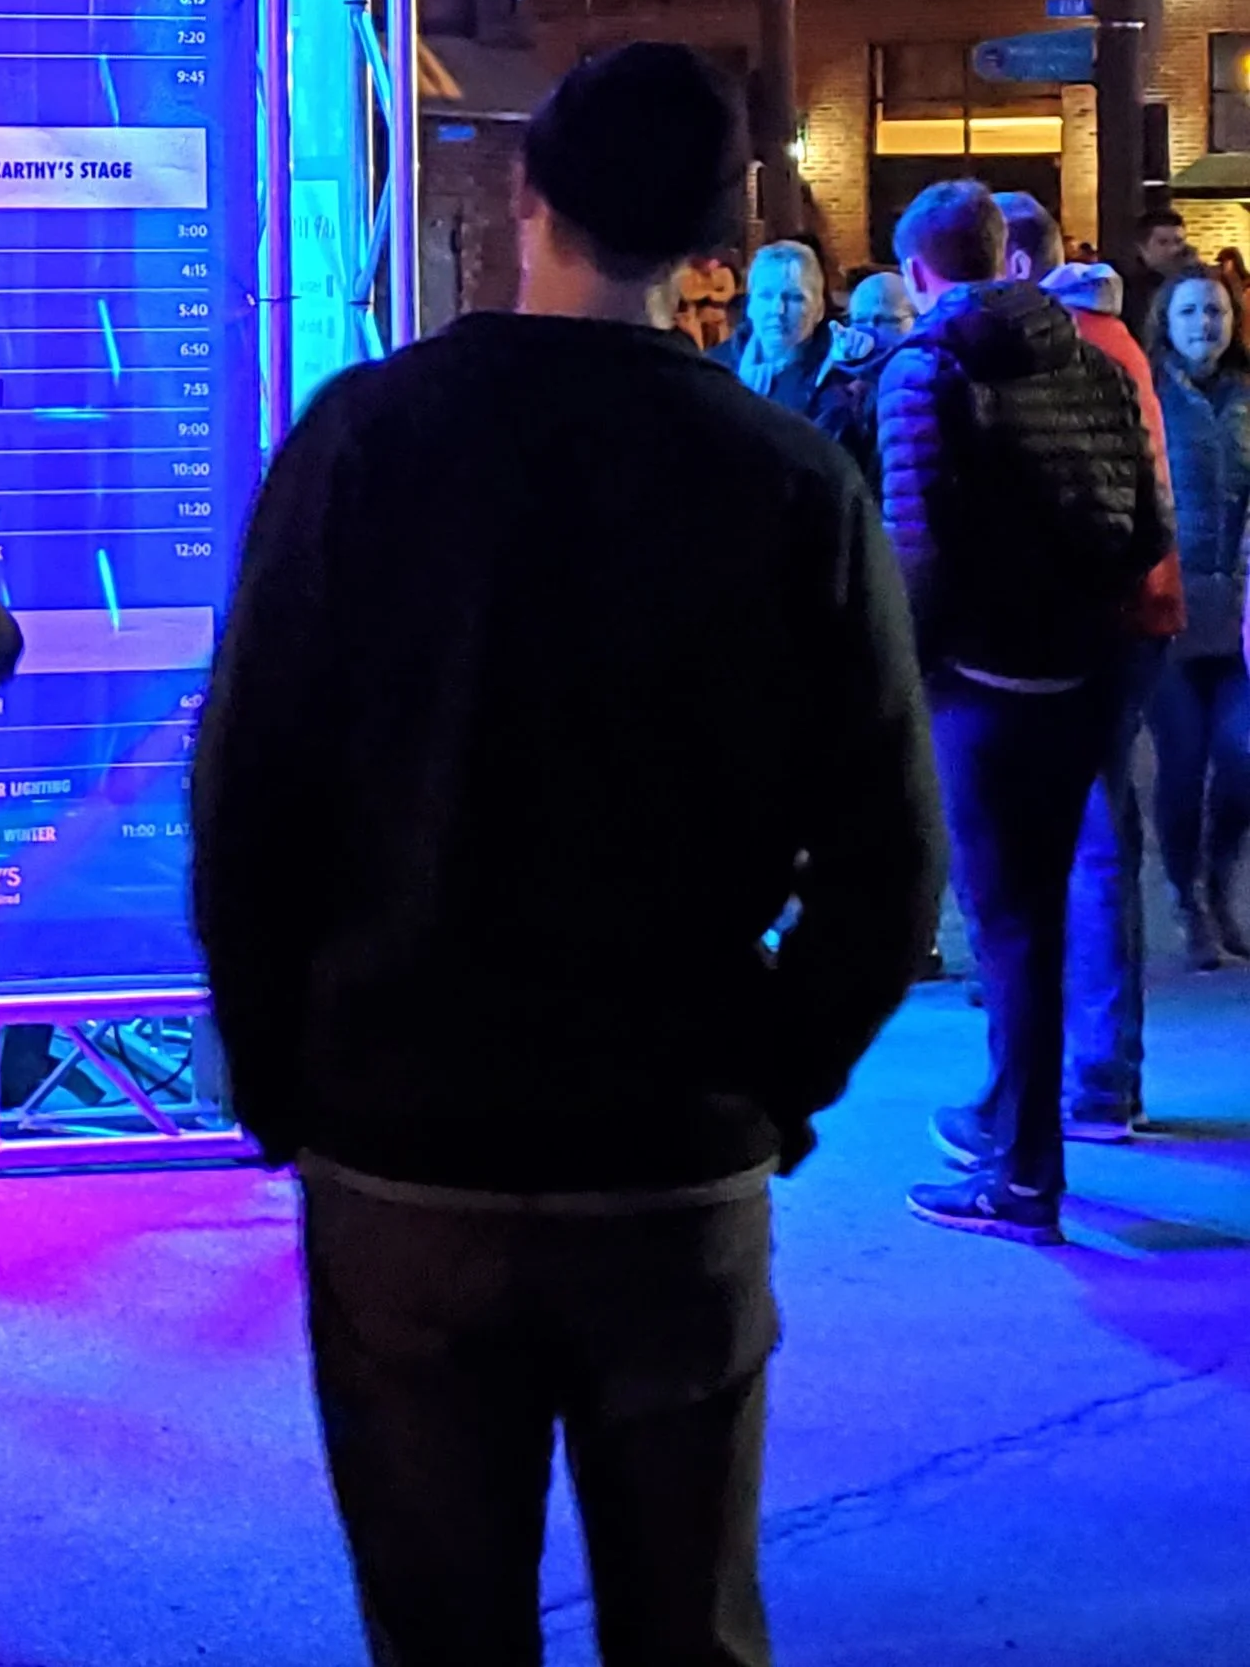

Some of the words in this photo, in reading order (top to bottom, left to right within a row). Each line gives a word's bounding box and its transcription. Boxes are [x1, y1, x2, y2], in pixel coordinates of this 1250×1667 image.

[178, 31, 205, 45] 7:20
[176, 70, 205, 85] 9:45
[79, 161, 132, 179] STAGE
[178, 224, 208, 238] 3:00
[181, 264, 207, 278] 4:15
[178, 302, 209, 317] 5:40
[180, 343, 209, 356] 6:50
[178, 423, 209, 437] 9:00
[173, 463, 210, 476] 10:00
[178, 504, 211, 516] 11:20
[175, 543, 211, 556] 12:00
[166, 823, 190, 836] LAT
